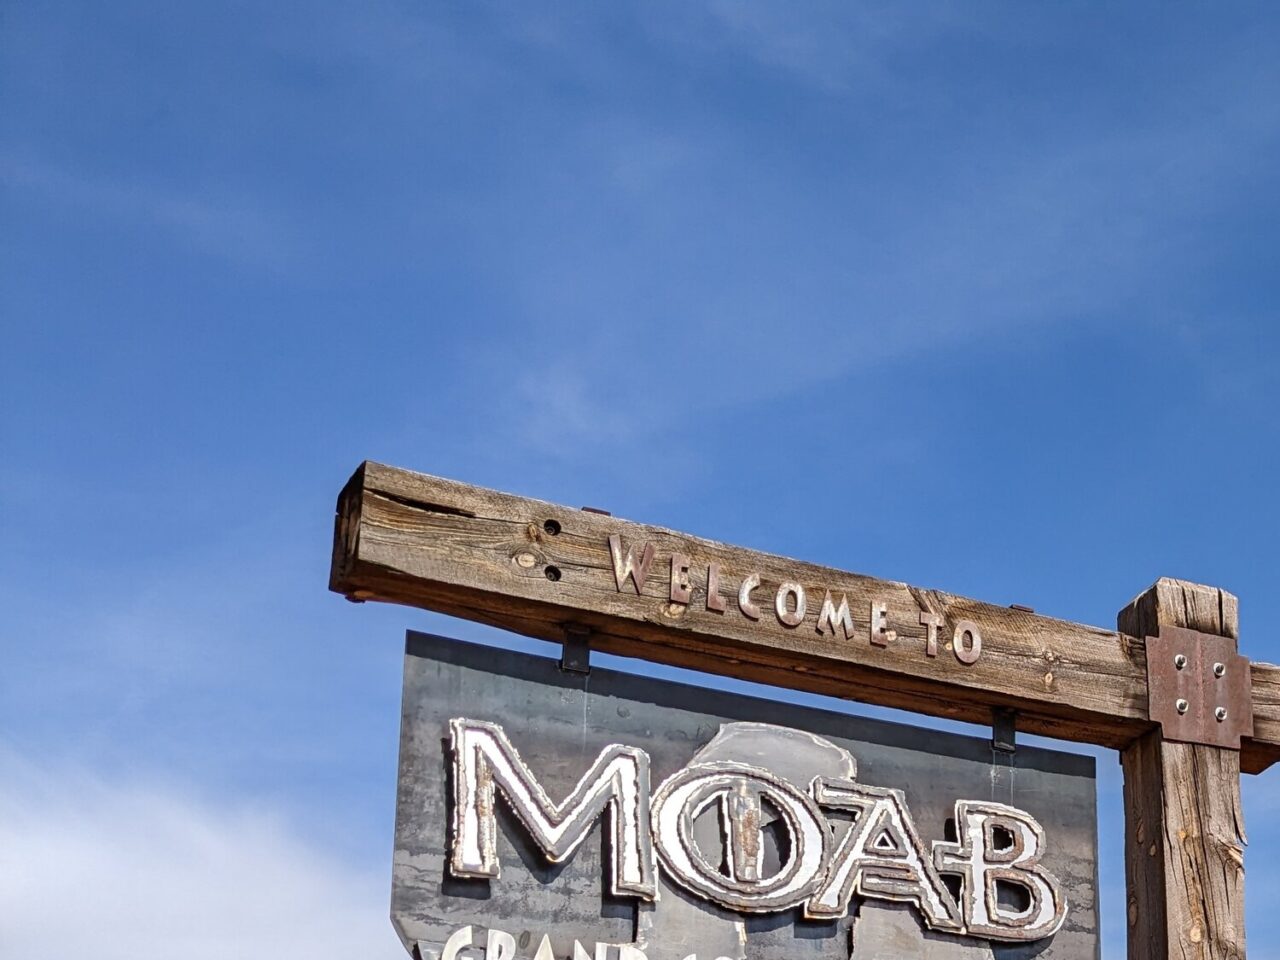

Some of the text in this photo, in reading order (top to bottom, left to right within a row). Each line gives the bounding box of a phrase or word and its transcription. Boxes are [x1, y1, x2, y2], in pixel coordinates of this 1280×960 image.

[607, 533, 982, 665] WELCOME TO
[447, 717, 1069, 942] MOAB
